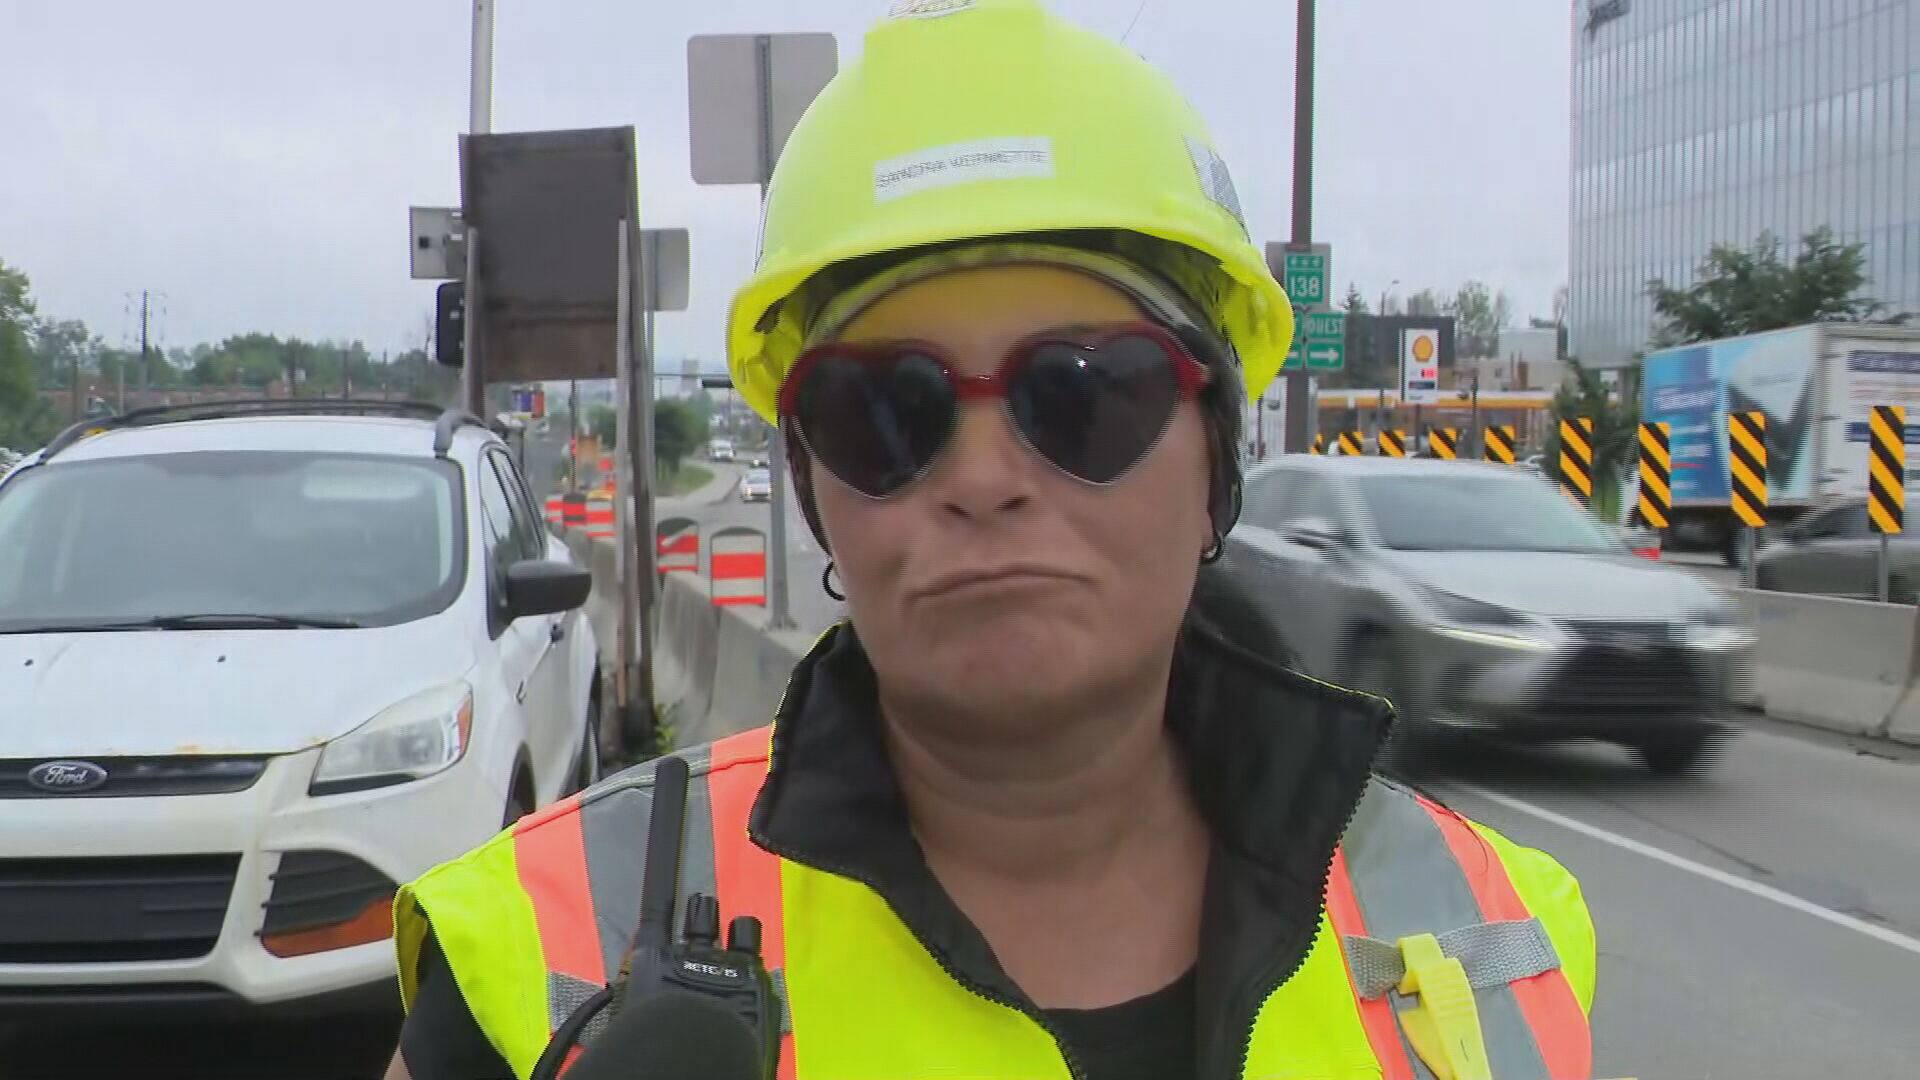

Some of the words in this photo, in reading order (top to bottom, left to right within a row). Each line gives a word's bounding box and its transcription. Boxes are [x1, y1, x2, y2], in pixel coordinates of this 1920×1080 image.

[876, 160, 947, 188] SANDRA
[949, 151, 1048, 168] VERMETTE
[1290, 276, 1320, 297] 138
[1308, 318, 1343, 335] OUEST
[44, 765, 88, 785] Ford
